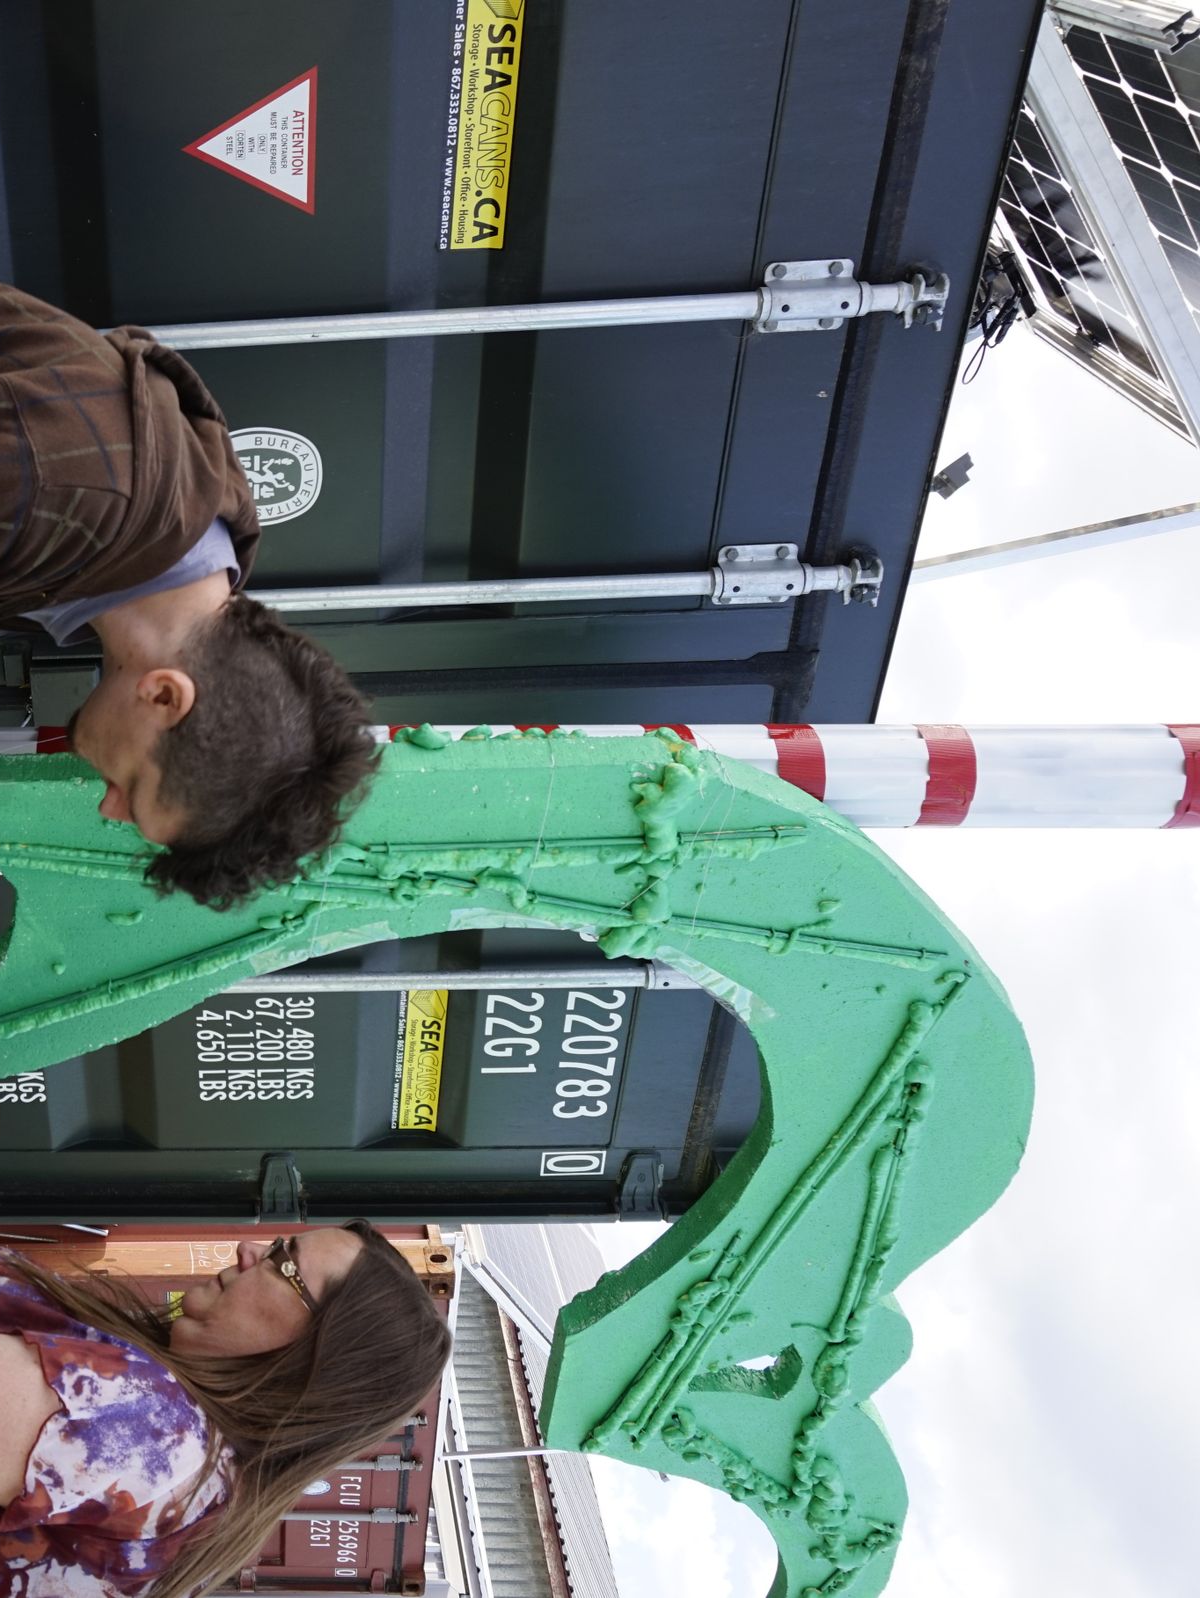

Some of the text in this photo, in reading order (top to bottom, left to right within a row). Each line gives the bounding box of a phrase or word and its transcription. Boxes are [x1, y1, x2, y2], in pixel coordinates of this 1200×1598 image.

[453, 24, 464, 56] Sales
[447, 68, 461, 146] 867.333.0812
[270, 133, 276, 141] BE
[292, 110, 304, 175] ATTENTION
[455, 24, 483, 243] Storage Workshop Storefront Office Housing
[472, 24, 516, 243] SEACANS.CA
[439, 157, 454, 249] www.seacans.ca
[255, 437, 314, 471] BUREAU
[256, 998, 284, 1100] 67,200 LBS
[286, 997, 314, 1099] 30,480 KGS
[410, 1019, 418, 1037] Storage
[481, 992, 544, 1074] 22G1
[196, 1010, 226, 1101] 4,650 LBS
[226, 1010, 255, 1101] 2,110 KGS
[394, 1040, 404, 1078] 867.333.0812
[408, 1041, 416, 1063] Workshop
[414, 1020, 441, 1126] SEACANS.CA
[553, 990, 626, 1119] 220783
[16, 1072, 46, 1103] KGS
[406, 1067, 414, 1089] Storefront
[391, 1083, 400, 1129] www.seacans.ca
[402, 1109, 410, 1126] Housing
[339, 1476, 361, 1505] FCIU
[310, 1520, 330, 1546] 22G1
[337, 1521, 359, 1562] 256966
